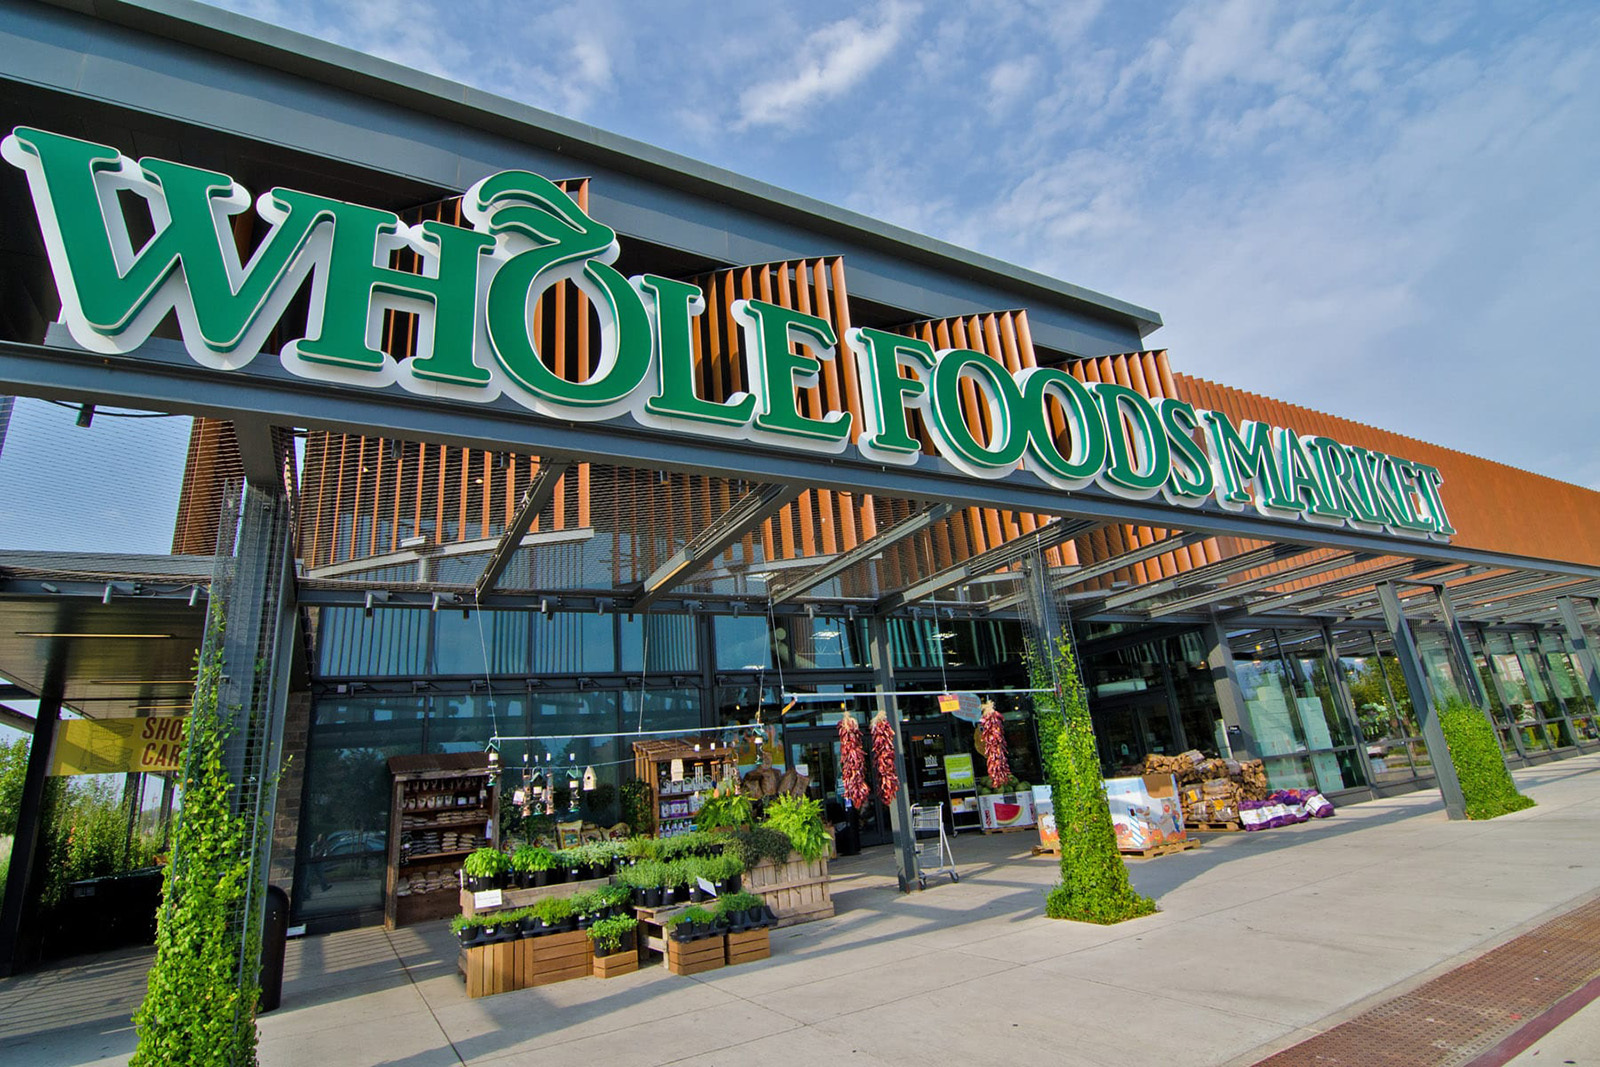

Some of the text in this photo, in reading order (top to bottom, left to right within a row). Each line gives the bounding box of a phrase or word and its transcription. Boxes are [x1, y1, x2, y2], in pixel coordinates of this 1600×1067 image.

[6, 125, 1457, 539] WHOLE FOODS MARKET
[142, 716, 186, 741] SHO
[141, 742, 187, 767] CAR
